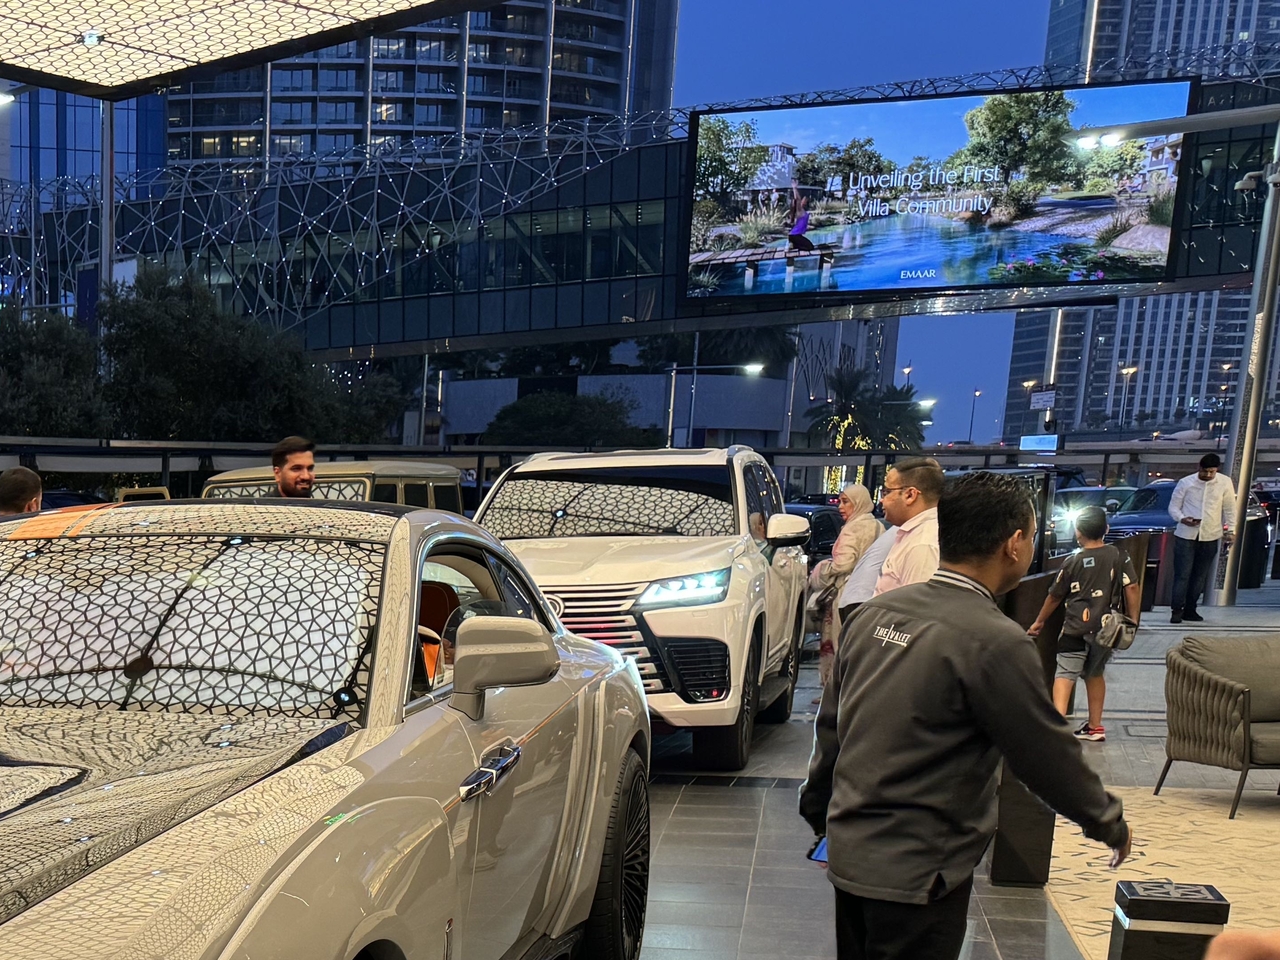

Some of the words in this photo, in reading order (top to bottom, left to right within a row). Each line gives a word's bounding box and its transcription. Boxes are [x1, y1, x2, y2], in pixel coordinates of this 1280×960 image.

[849, 168, 923, 190] Unveiling
[929, 167, 958, 185] the
[963, 164, 1001, 183] First
[858, 198, 890, 217] Villa
[895, 195, 994, 215] Community
[900, 269, 936, 279] EMAAR
